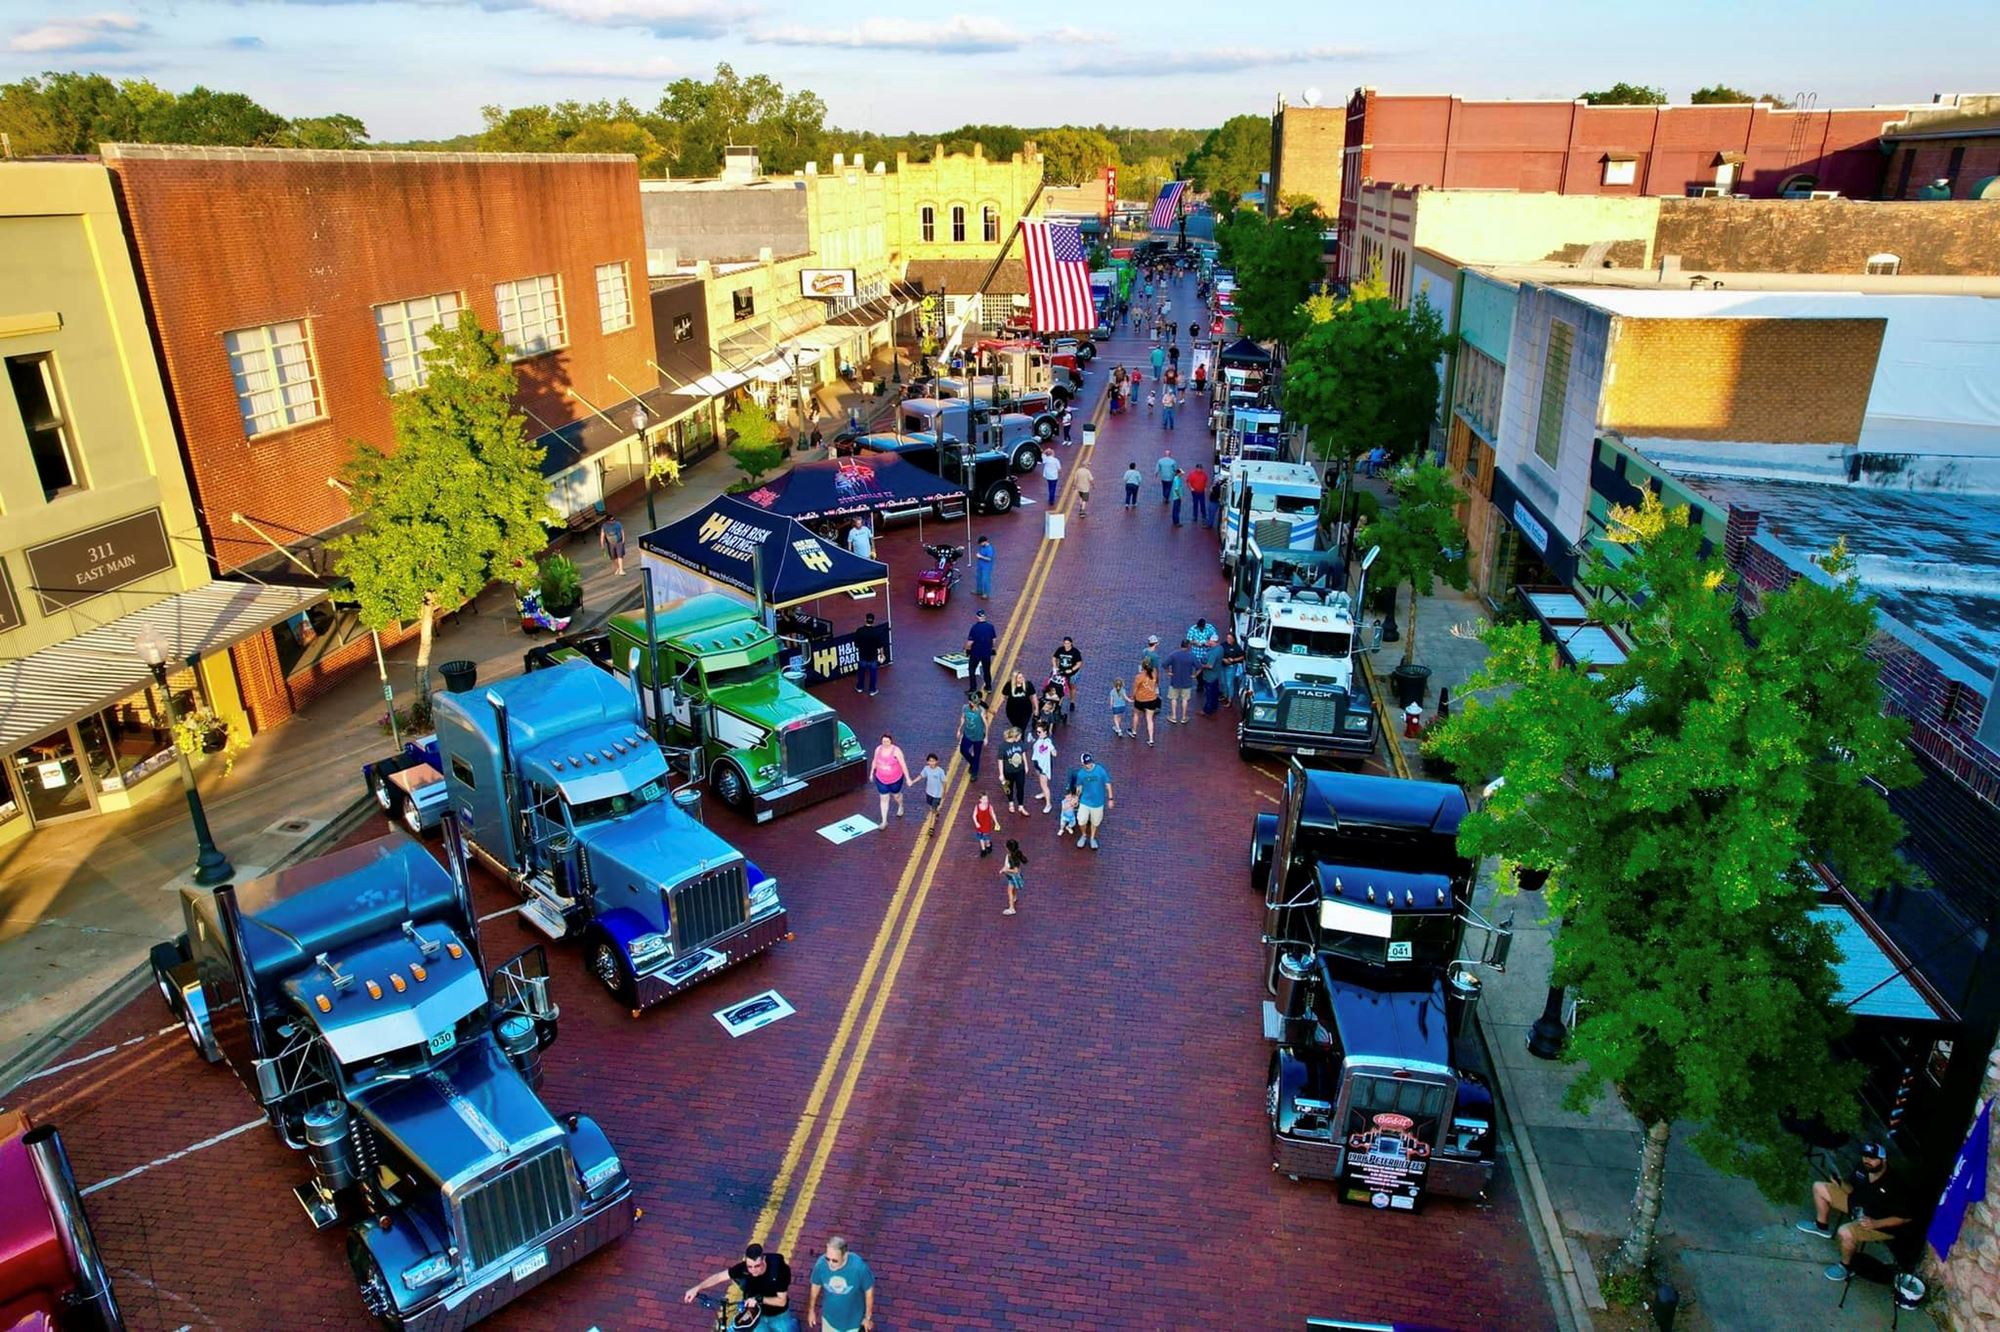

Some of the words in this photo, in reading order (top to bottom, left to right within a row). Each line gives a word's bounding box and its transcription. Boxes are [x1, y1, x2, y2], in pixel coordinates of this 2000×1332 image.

[727, 520, 753, 538] H&H
[745, 526, 773, 544] RISK
[88, 542, 115, 563] 311
[710, 542, 753, 562] INSURANCE
[717, 532, 757, 554] PARTNER
[75, 565, 105, 585] EAST
[106, 554, 137, 574] MAIN
[1297, 689, 1332, 698] MACK
[1392, 947, 1408, 956] 041
[432, 1032, 452, 1047] 030
